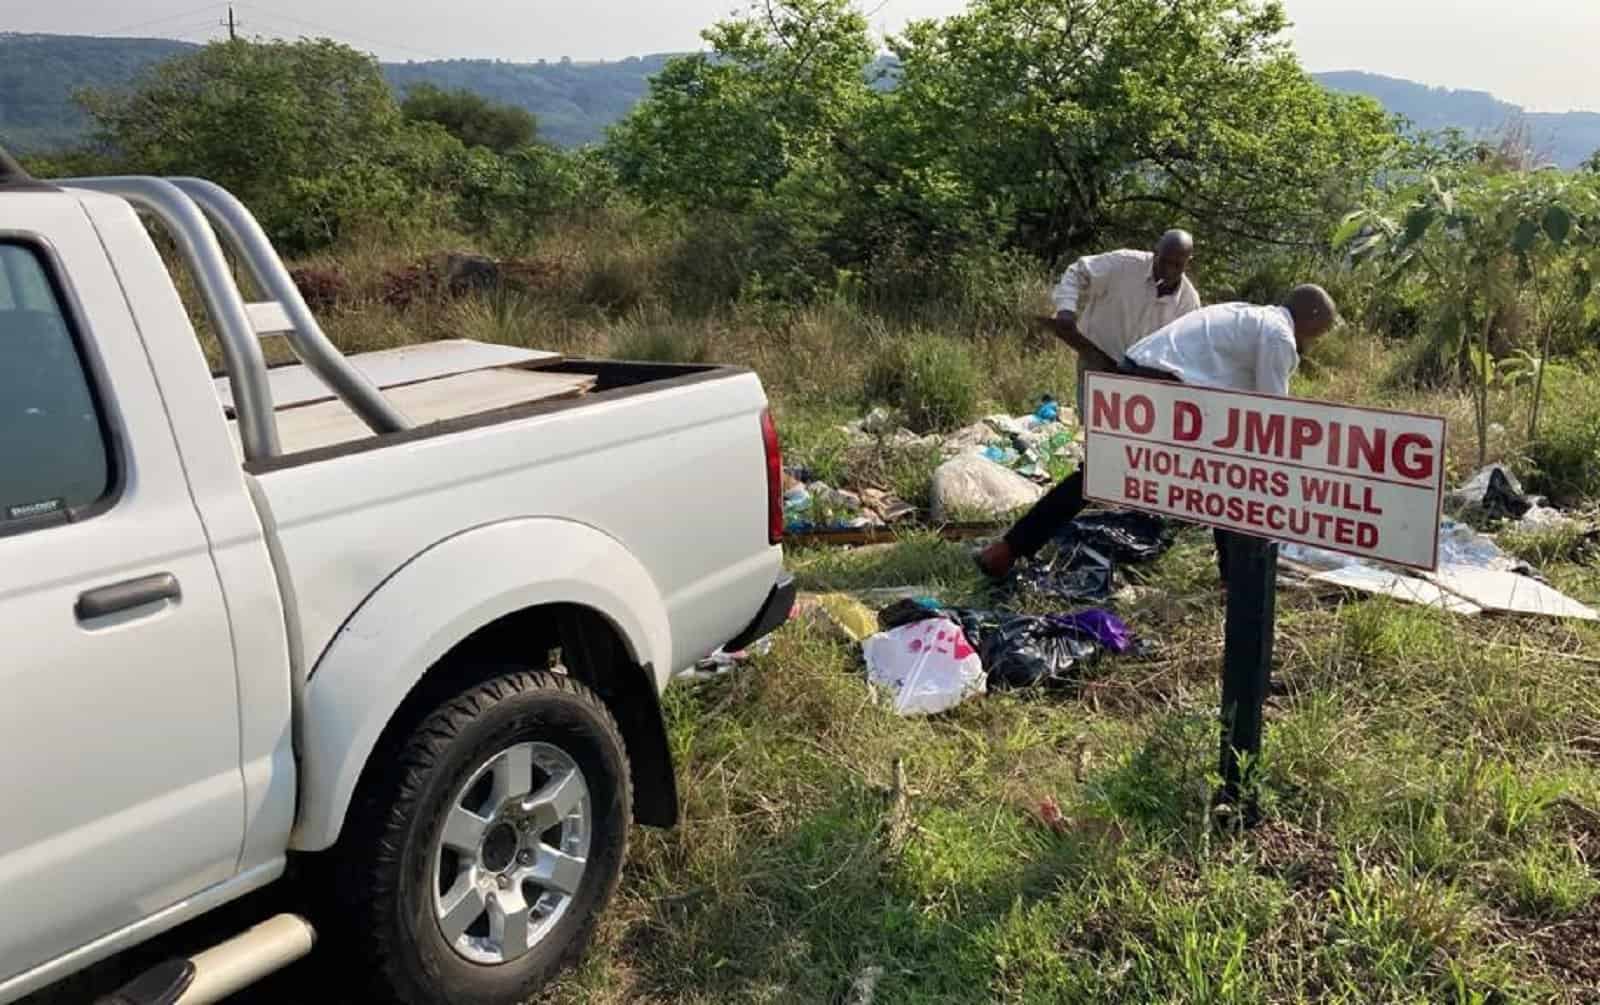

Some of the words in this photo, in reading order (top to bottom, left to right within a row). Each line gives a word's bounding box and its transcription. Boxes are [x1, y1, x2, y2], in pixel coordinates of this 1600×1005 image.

[1091, 390, 1156, 434] NO
[1124, 476, 1158, 505] BE
[1167, 482, 1380, 549] PROSECUTED
[1125, 446, 1290, 498] VIOLATORS
[1300, 475, 1383, 515] WILL
